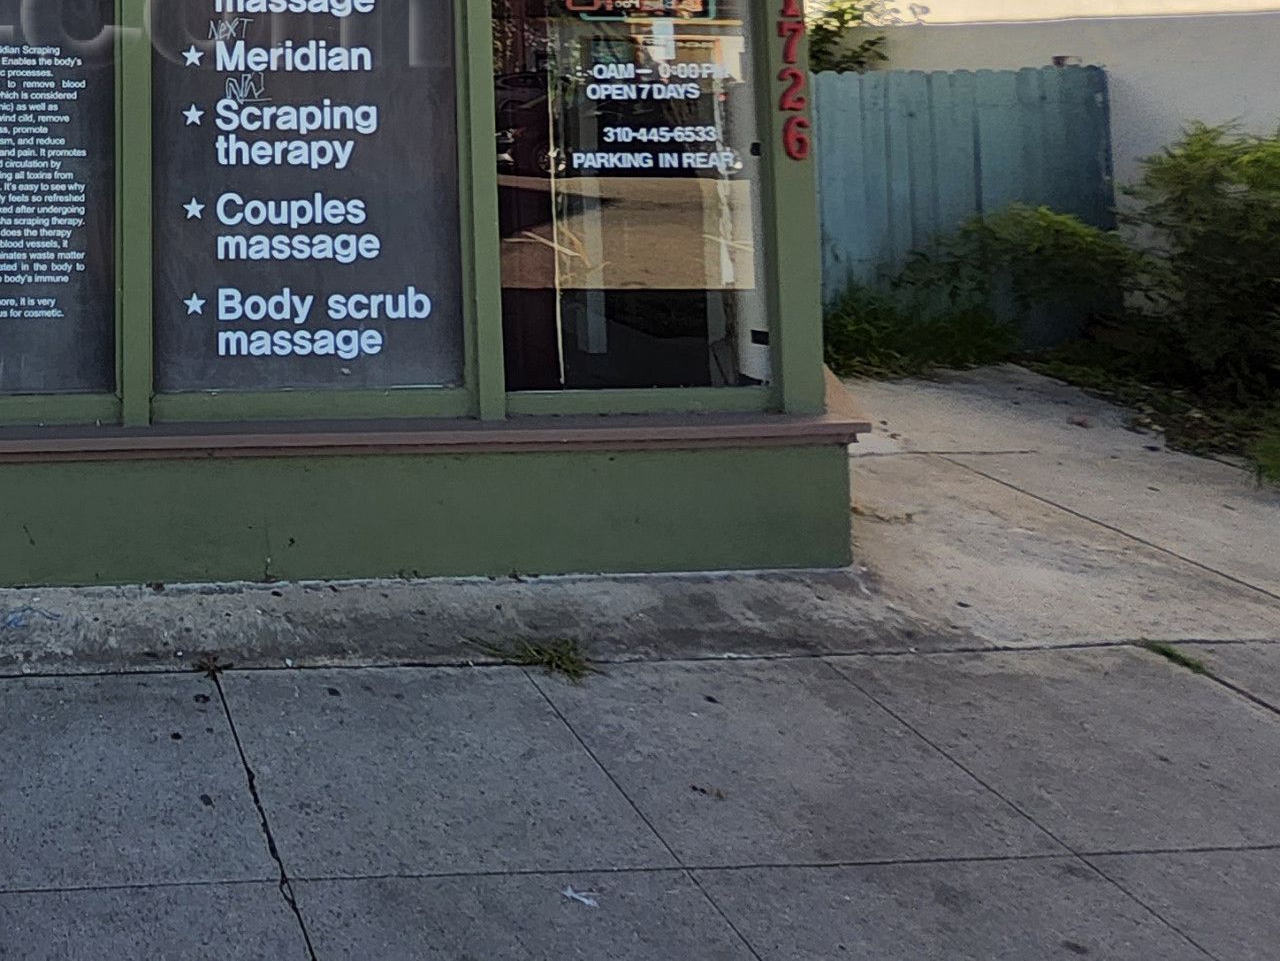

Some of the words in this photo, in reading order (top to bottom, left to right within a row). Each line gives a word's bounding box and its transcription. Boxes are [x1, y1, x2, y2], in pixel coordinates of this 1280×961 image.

[22, 45, 60, 55] Scraping
[2, 57, 36, 65] Enables
[39, 57, 52, 65] the
[216, 40, 372, 72] Meridian
[8, 80, 16, 88] to
[62, 80, 85, 88] blood
[21, 91, 28, 99] is
[30, 91, 77, 99] considered
[586, 83, 637, 100] OPEN
[639, 83, 651, 100] 7
[653, 83, 700, 100] DAYS
[29, 102, 45, 111] well
[215, 98, 377, 134] Scraping
[13, 125, 48, 135] promote
[603, 126, 717, 143] 310-445-6533
[18, 136, 34, 145] and
[36, 136, 65, 145] reduce
[0, 148, 15, 156] and
[40, 148, 45, 156] It
[48, 148, 86, 158] promotes
[215, 134, 354, 169] therapy
[5, 159, 48, 168] circulation
[51, 159, 61, 169] by
[572, 152, 654, 169] PARKING
[658, 152, 680, 168] IN
[682, 152, 734, 168] REAR
[15, 171, 25, 179] all
[27, 171, 52, 179] toxins
[54, 171, 73, 179] from
[19, 184, 39, 192] easy
[41, 182, 49, 191] to
[68, 182, 85, 192] why
[9, 194, 29, 202] feels
[45, 194, 85, 202] refreshed
[15, 205, 35, 213] after
[37, 205, 85, 215] undergoing
[216, 192, 367, 228] Couples
[14, 216, 49, 226] scraping
[1, 228, 22, 236] does
[24, 228, 37, 236] the
[40, 228, 72, 238] therapy
[0, 239, 23, 248] blood
[62, 239, 68, 248] it
[217, 234, 381, 263] massage
[30, 251, 55, 259] waste
[57, 251, 85, 259] matter
[22, 262, 29, 271] in
[34, 262, 47, 271] the
[51, 262, 72, 272] body
[77, 262, 85, 271] to
[35, 274, 69, 283] immune
[20, 297, 25, 306] it
[28, 297, 35, 306] is
[37, 299, 55, 307] very
[218, 288, 313, 324] Body
[327, 287, 432, 319] scrub
[10, 309, 22, 317] for
[218, 329, 383, 359] massage
